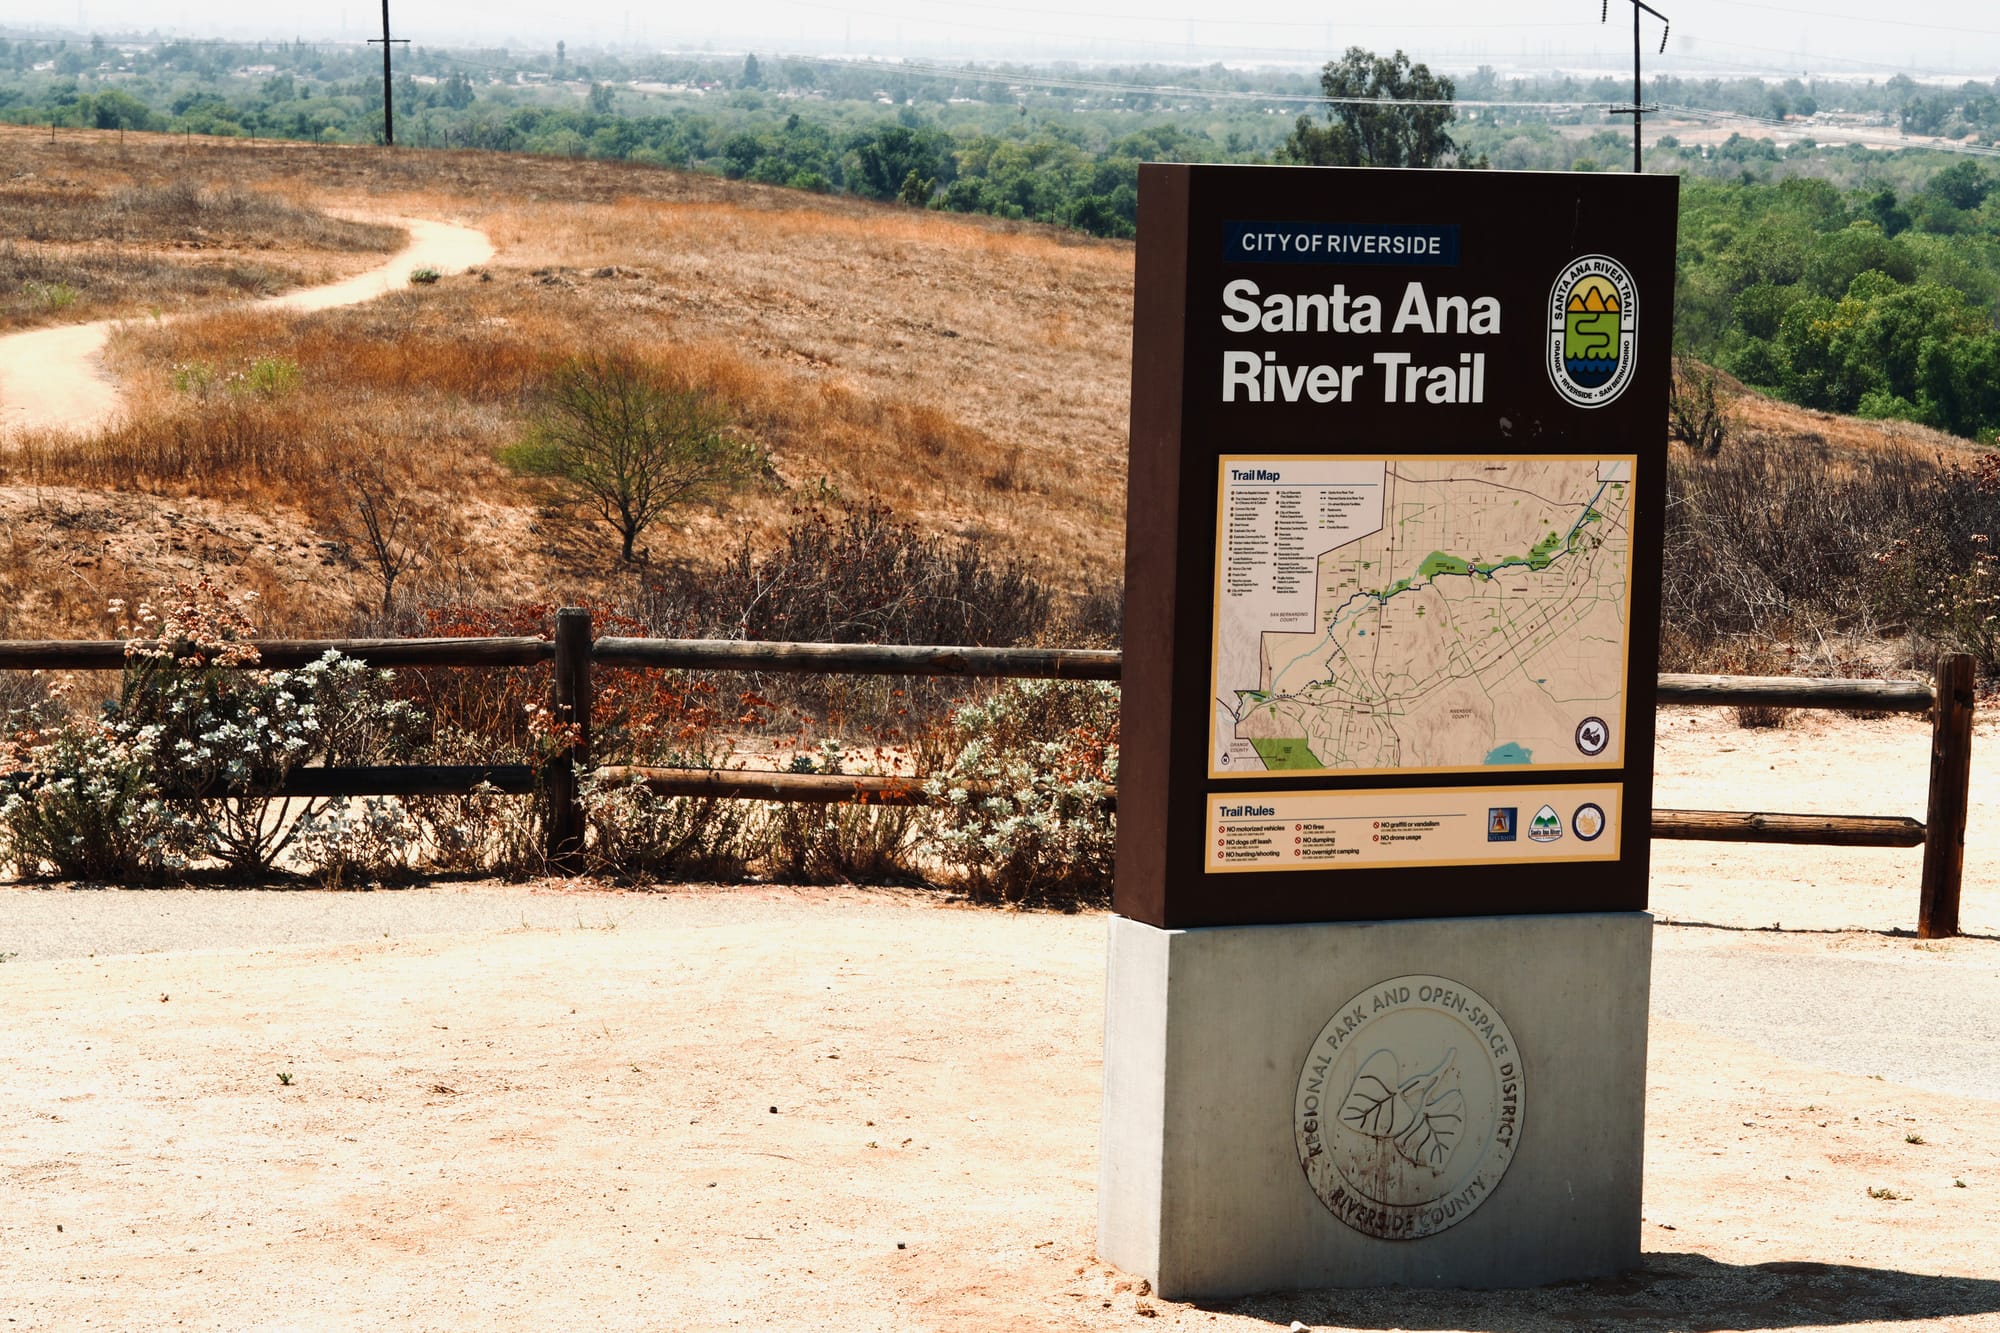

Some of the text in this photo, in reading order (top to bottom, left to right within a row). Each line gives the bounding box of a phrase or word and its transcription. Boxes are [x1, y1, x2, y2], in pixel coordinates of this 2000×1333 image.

[1242, 233, 1441, 254] CITY OF RIVERSIDE
[1221, 278, 1501, 335] Santa Ana
[1555, 262, 1632, 321] SANTA ANA RIVER TRAIL
[1222, 351, 1485, 404] River Trail
[1554, 340, 1630, 399] ORANGE RIVERSIDE SAN BERNARDINO
[1232, 470, 1280, 483] Trail Map
[1220, 805, 1275, 817] Trail Rules
[1304, 985, 1517, 1157] REGIONAL PARK AND OPEN-SPACE DISTRICT
[1331, 1175, 1486, 1232] RIVERSIDE COUNTY
